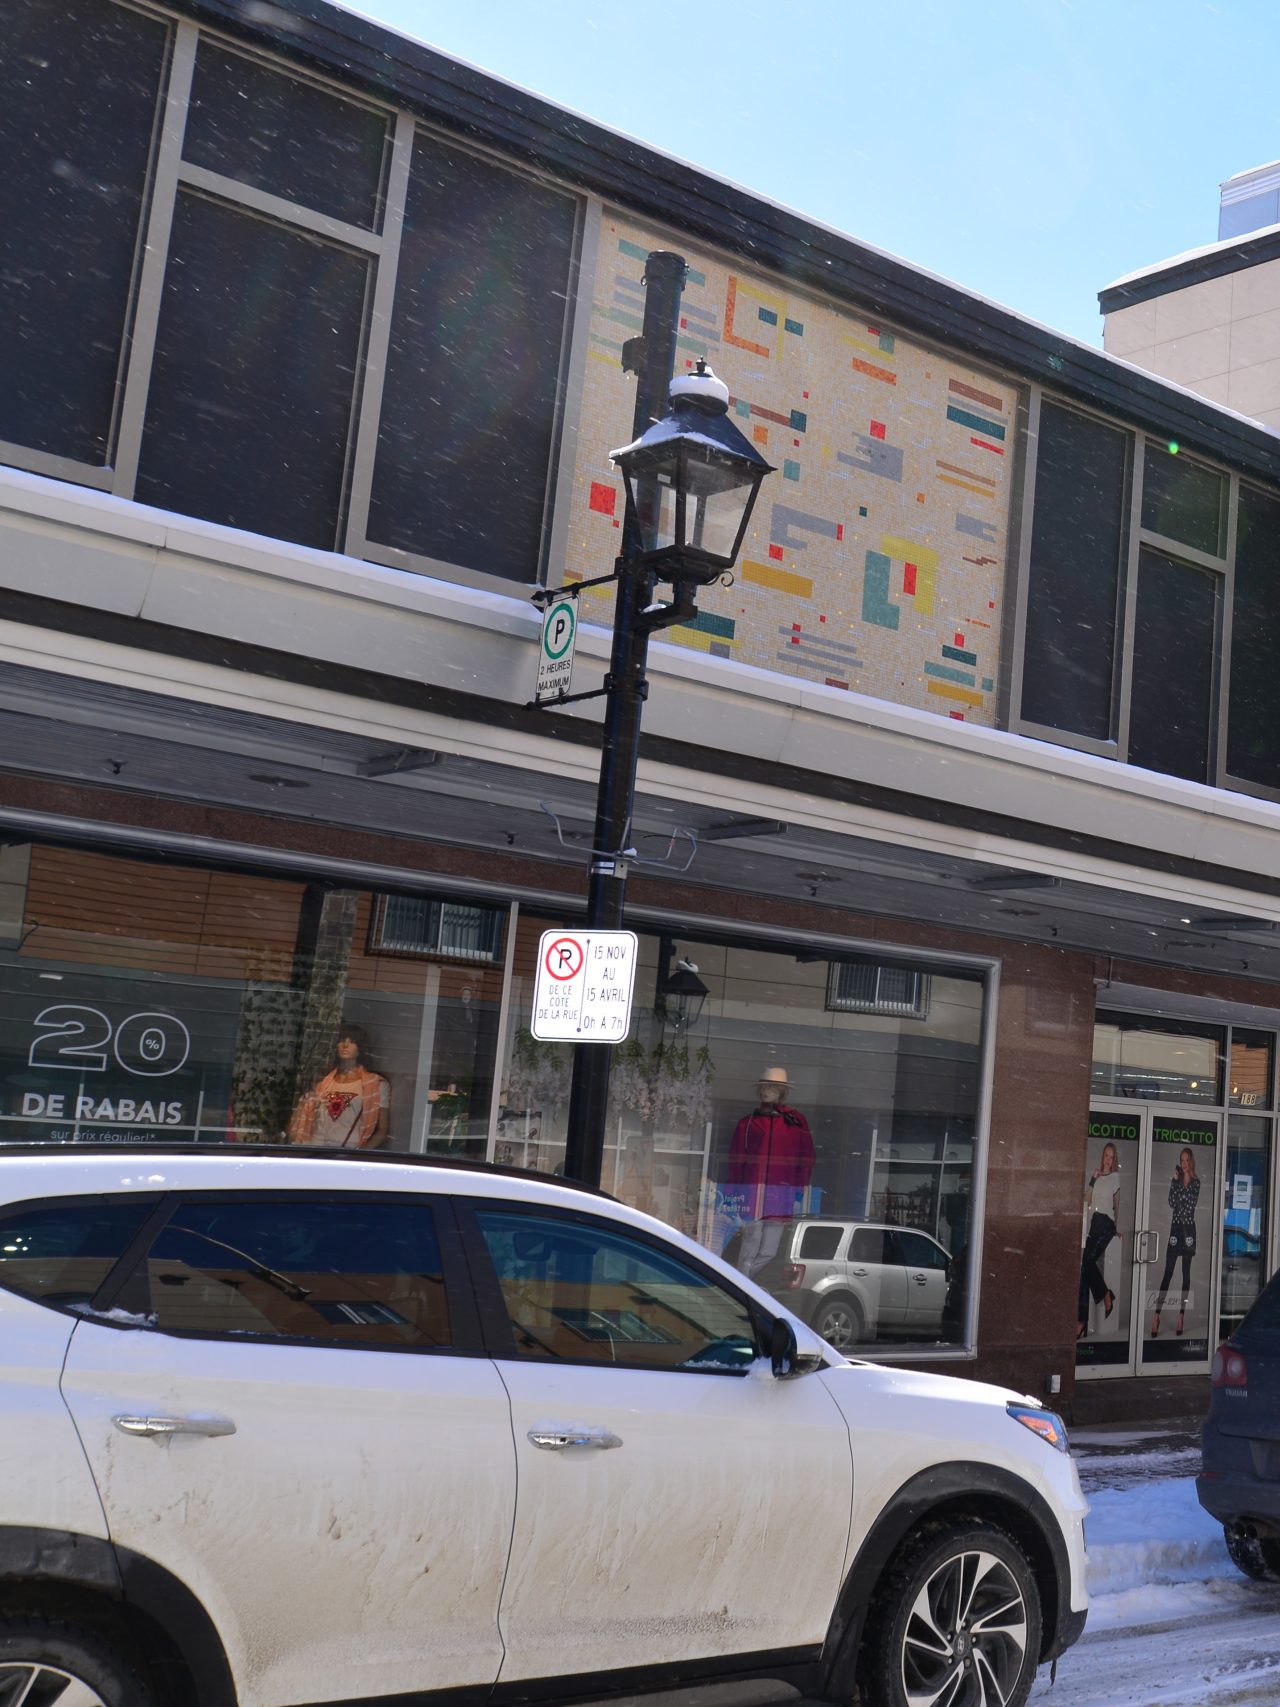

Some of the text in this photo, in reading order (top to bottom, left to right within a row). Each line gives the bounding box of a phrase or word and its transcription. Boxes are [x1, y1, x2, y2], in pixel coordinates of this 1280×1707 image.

[540, 660, 571, 675] 2 HEURES
[538, 676, 569, 691] MAXIMUM
[594, 946, 604, 960] 15
[603, 967, 616, 981] AU
[549, 985, 573, 996] DE CE
[587, 988, 626, 1002] 15 AVRIL
[538, 1009, 579, 1020] DE LA RUE
[611, 1016, 623, 1030] 7h
[28, 1004, 190, 1077] 20
[1243, 1094, 1256, 1105] 188
[22, 1093, 183, 1125] DE RABAIS
[50, 1129, 71, 1140] sur
[74, 1129, 97, 1141] prix
[1088, 1123, 1137, 1139] ICOTTO
[1154, 1128, 1214, 1144] TRICOTTO
